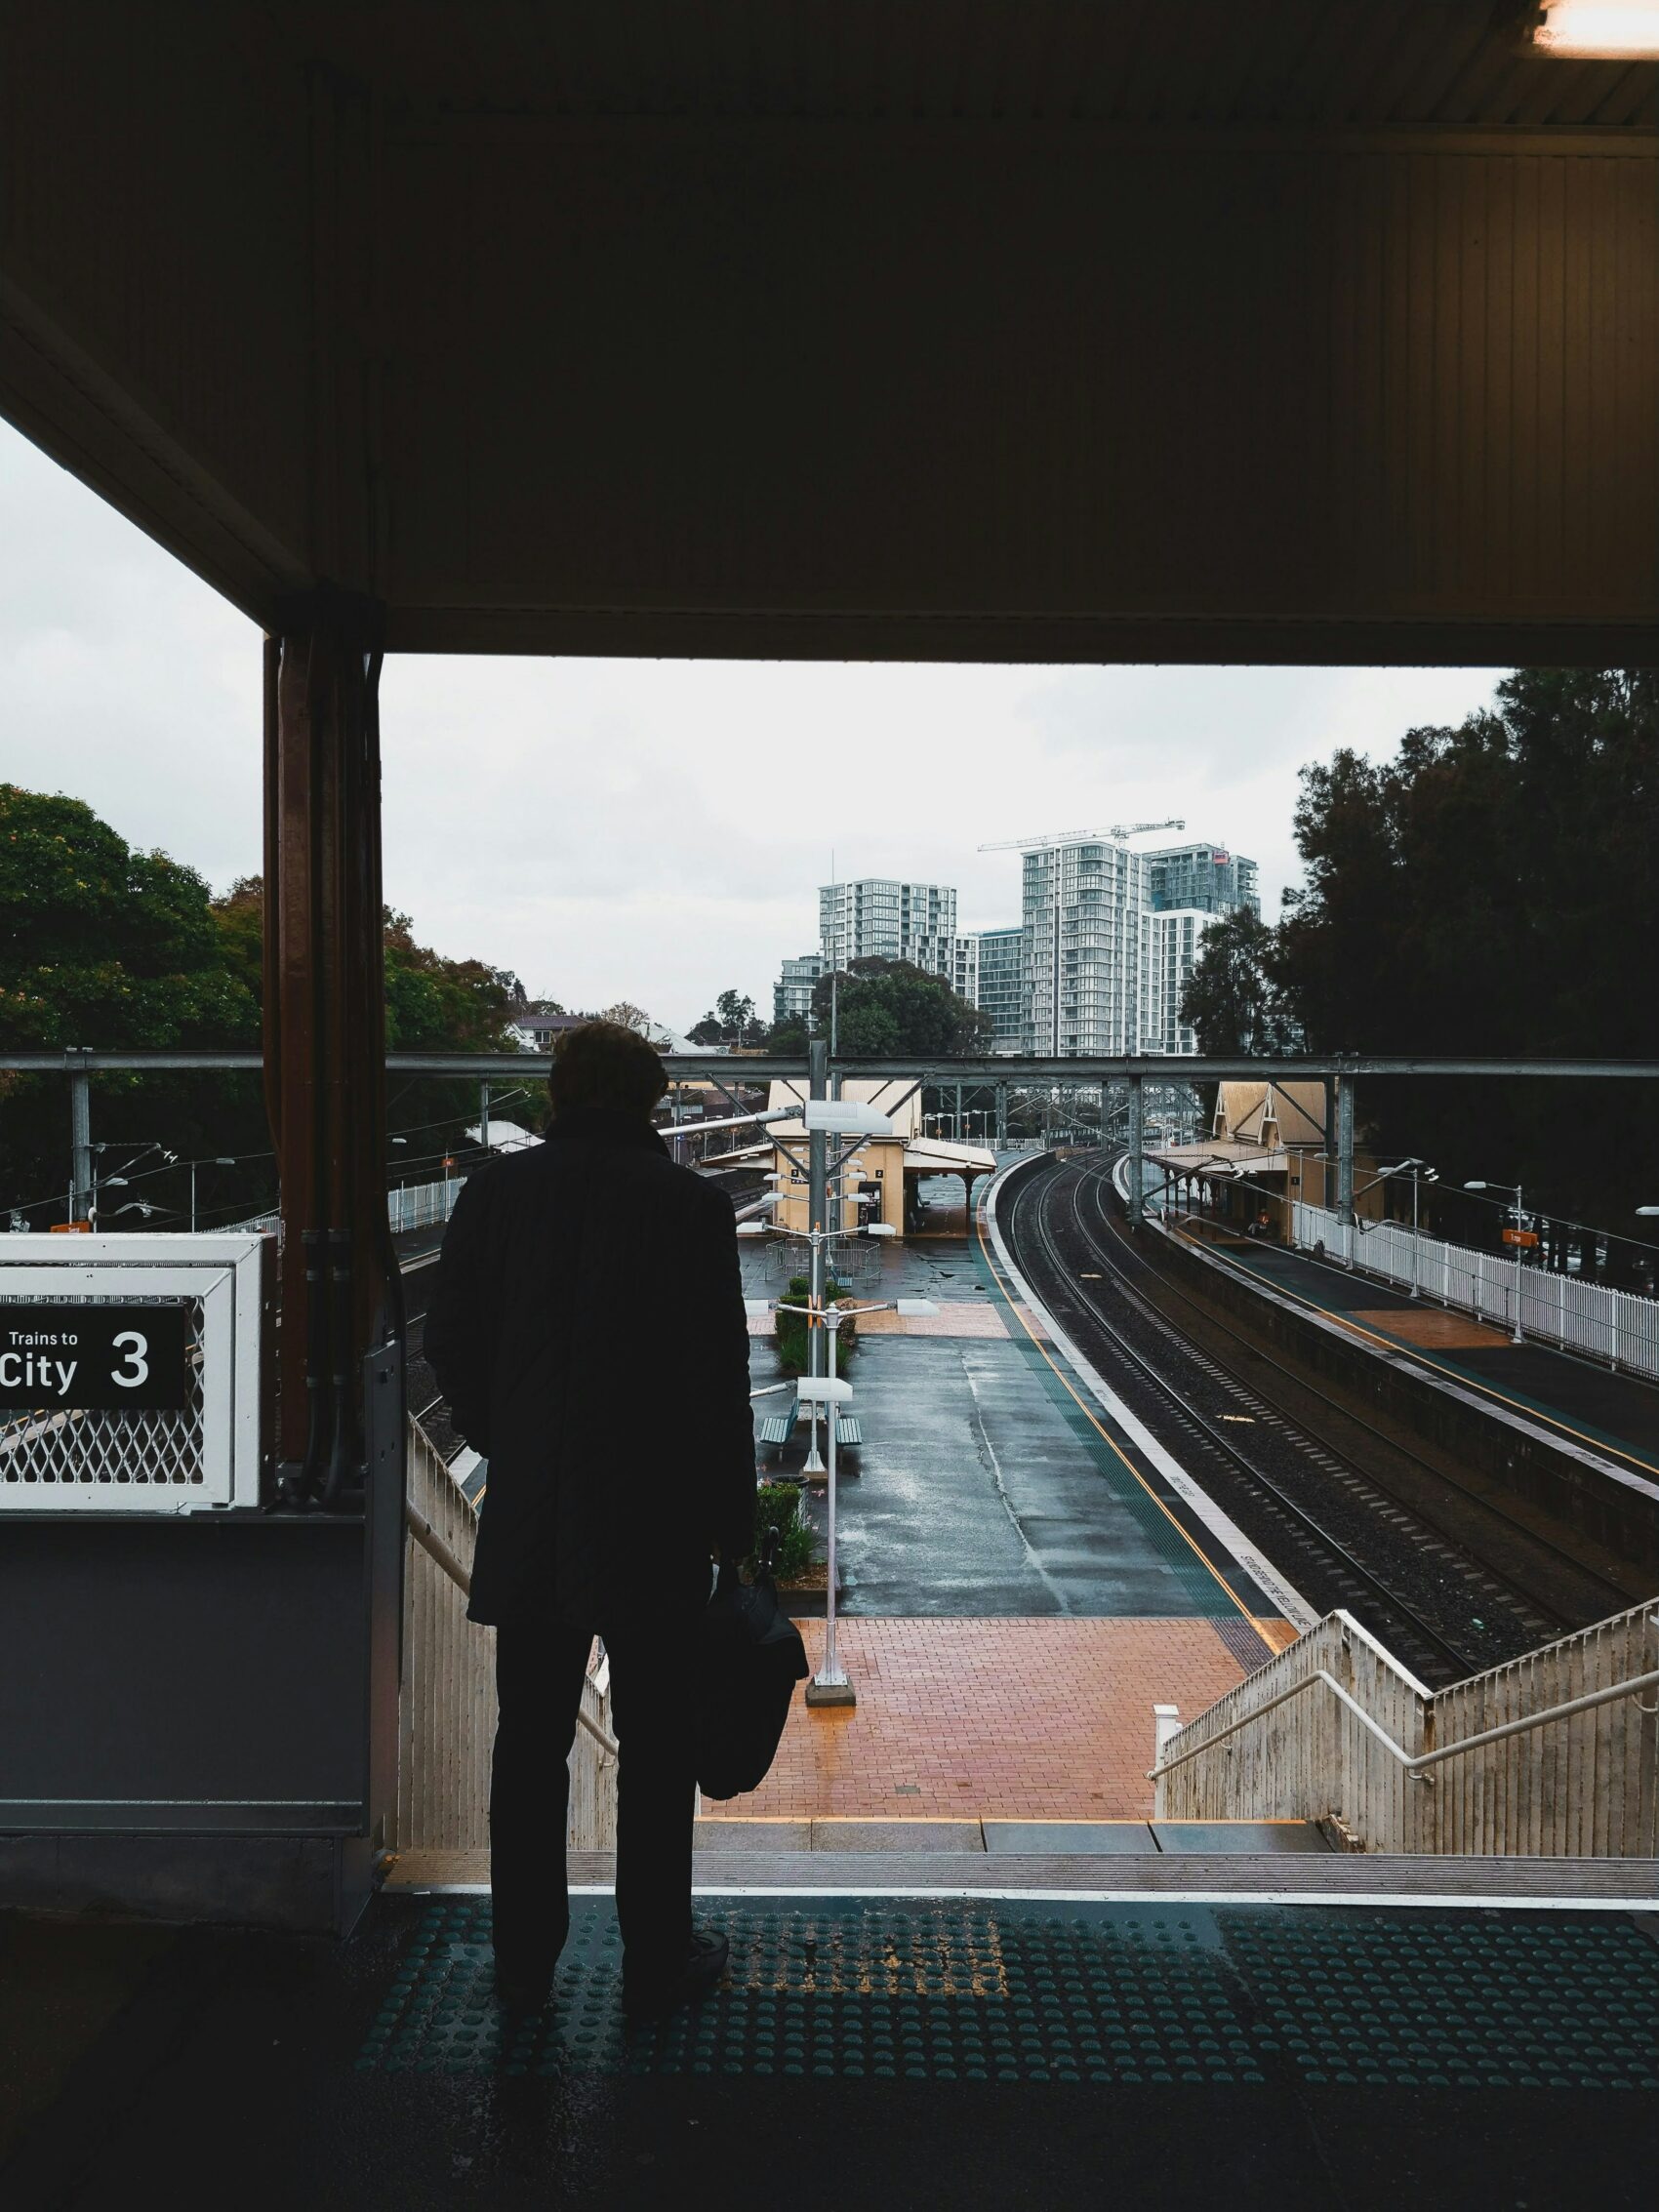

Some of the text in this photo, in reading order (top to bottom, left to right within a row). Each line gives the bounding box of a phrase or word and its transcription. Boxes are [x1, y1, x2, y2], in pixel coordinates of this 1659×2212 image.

[9, 1331, 78, 1346] Trains to
[110, 1331, 149, 1388] 3
[0, 1352, 78, 1396] City
